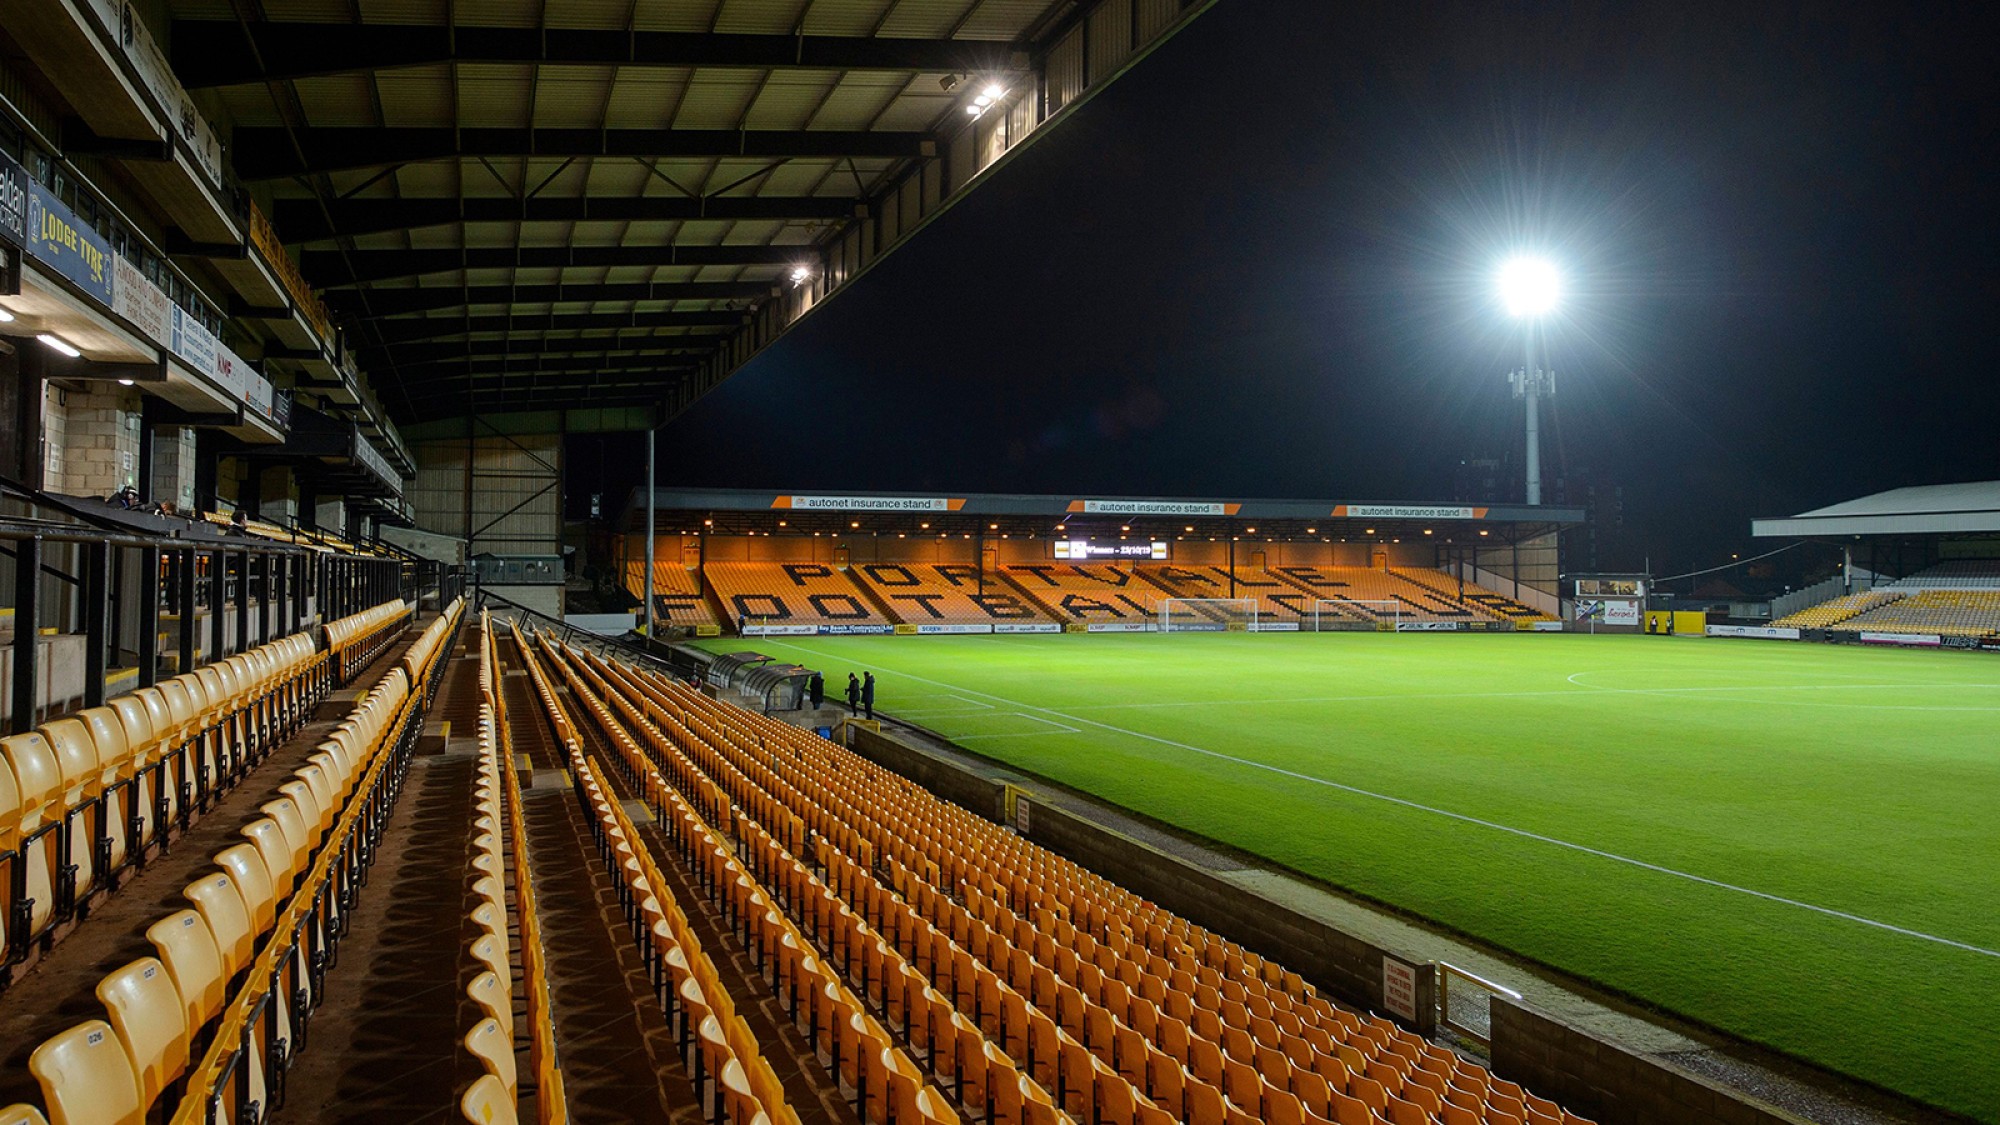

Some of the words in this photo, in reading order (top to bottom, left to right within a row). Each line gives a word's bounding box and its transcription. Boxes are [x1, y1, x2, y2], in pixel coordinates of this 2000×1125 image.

[41, 207, 77, 252] LODGE
[80, 236, 103, 283] TYRE
[808, 498, 849, 508] autonet
[850, 499, 901, 509] insurance
[903, 500, 931, 509] stand
[1099, 503, 1136, 512] autonet
[1137, 503, 1182, 513] insurance
[1184, 504, 1210, 513] stand
[1361, 507, 1393, 516] autonet
[1394, 507, 1435, 517] insurance
[1437, 508, 1460, 517] stand
[780, 564, 1060, 586] PORT
[1070, 565, 1350, 587] VALE
[652, 594, 1278, 620] FOOTBALL
[1267, 594, 1543, 618] CLUB
